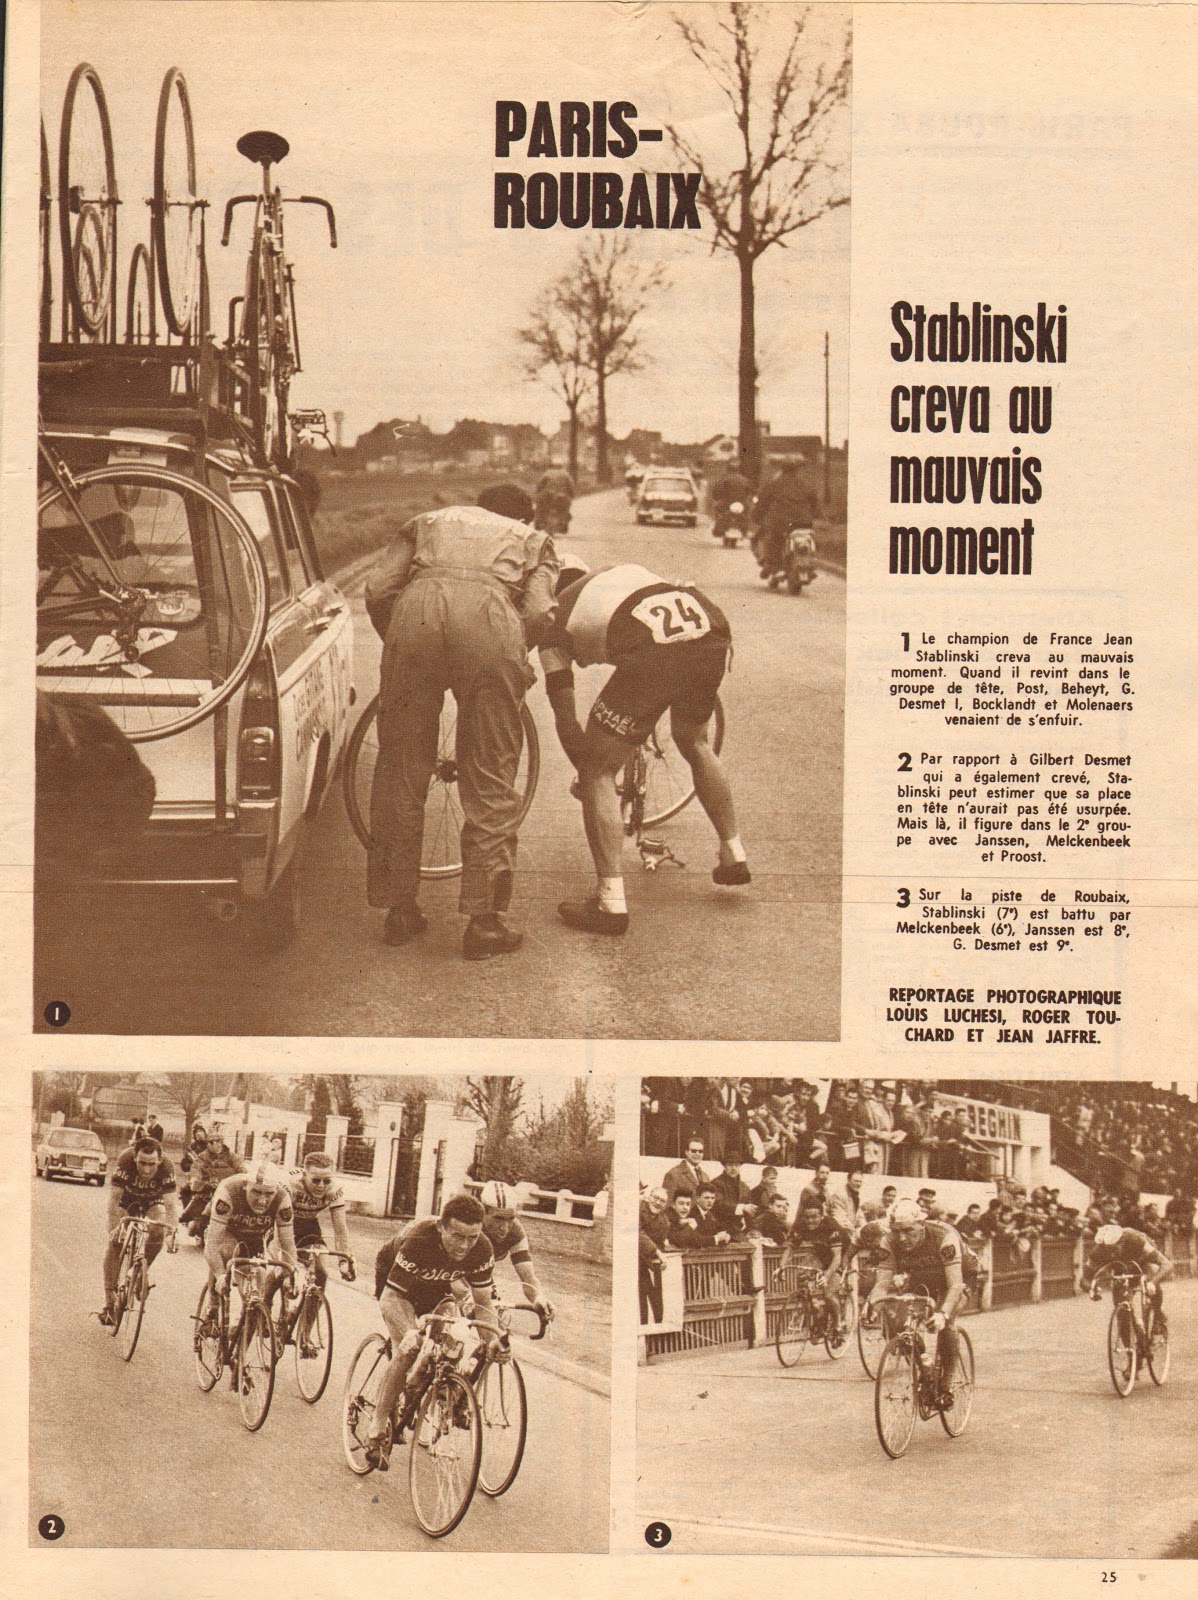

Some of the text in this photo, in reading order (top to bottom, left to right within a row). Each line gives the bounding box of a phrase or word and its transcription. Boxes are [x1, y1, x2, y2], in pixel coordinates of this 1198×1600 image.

[495, 101, 663, 159] PARIS-
[494, 172, 702, 229] ROUBAIX
[890, 300, 1067, 363] Stablinski
[890, 385, 1052, 434] creva au
[890, 446, 1042, 504] mauvais
[889, 518, 1035, 575] moment
[650, 598, 702, 638] 24
[901, 632, 1132, 652] 1 Le champion de France Jean
[916, 650, 1134, 663] Stablinski creva au mauvais
[892, 666, 1130, 679] moment. Quand il revint dans le
[890, 682, 1135, 697] groupe de tête, Post, Beheyt, G.
[900, 698, 945, 709] Desmet
[973, 698, 1036, 710] Bocklandt
[1045, 699, 1057, 710] et
[1066, 698, 1133, 711] Molenaers
[945, 713, 1082, 726] venaient de s'enfuir.
[897, 752, 1131, 772] 2 Par rapport à Gilbert Desmet
[923, 771, 1132, 785] qui a également crevé, Sta-
[898, 785, 1131, 801] blinski peut estimer que sa place
[897, 801, 1130, 817] en tête n'aurait pas été usurpée.
[897, 817, 927, 829] Mais
[936, 817, 950, 831] là,
[959, 817, 966, 829] il
[974, 817, 1012, 832] figure
[1021, 818, 1051, 830] dans
[1059, 818, 1069, 831] le
[1097, 822, 1131, 833] grou-
[897, 834, 1130, 848] pe avec Janssen, Melckenbeek
[981, 850, 1046, 862] et Proost.
[896, 888, 1129, 908] 3 Sur la piste de Roubaix,
[923, 906, 985, 919] Stablinski
[1030, 909, 1049, 919] est
[1062, 907, 1095, 920] battu
[1110, 912, 1131, 923] par
[896, 921, 980, 934] Melckenbeek
[1025, 923, 1074, 935] Janssen
[1084, 925, 1103, 936] est
[953, 938, 966, 950] G.
[975, 939, 1021, 951] Desmet
[1029, 941, 1048, 951] est
[890, 988, 1121, 1006] REPORTAGE PHOTOGRAPHIQUE
[887, 1008, 1121, 1025] LOUIS LUCHESI, ROGER TOU-
[905, 1028, 1101, 1044] CHARD ET JEAN JAFFRE.
[47, 1519, 57, 1534] 2
[653, 1528, 663, 1542] 3
[1101, 1571, 1117, 1583] 25
